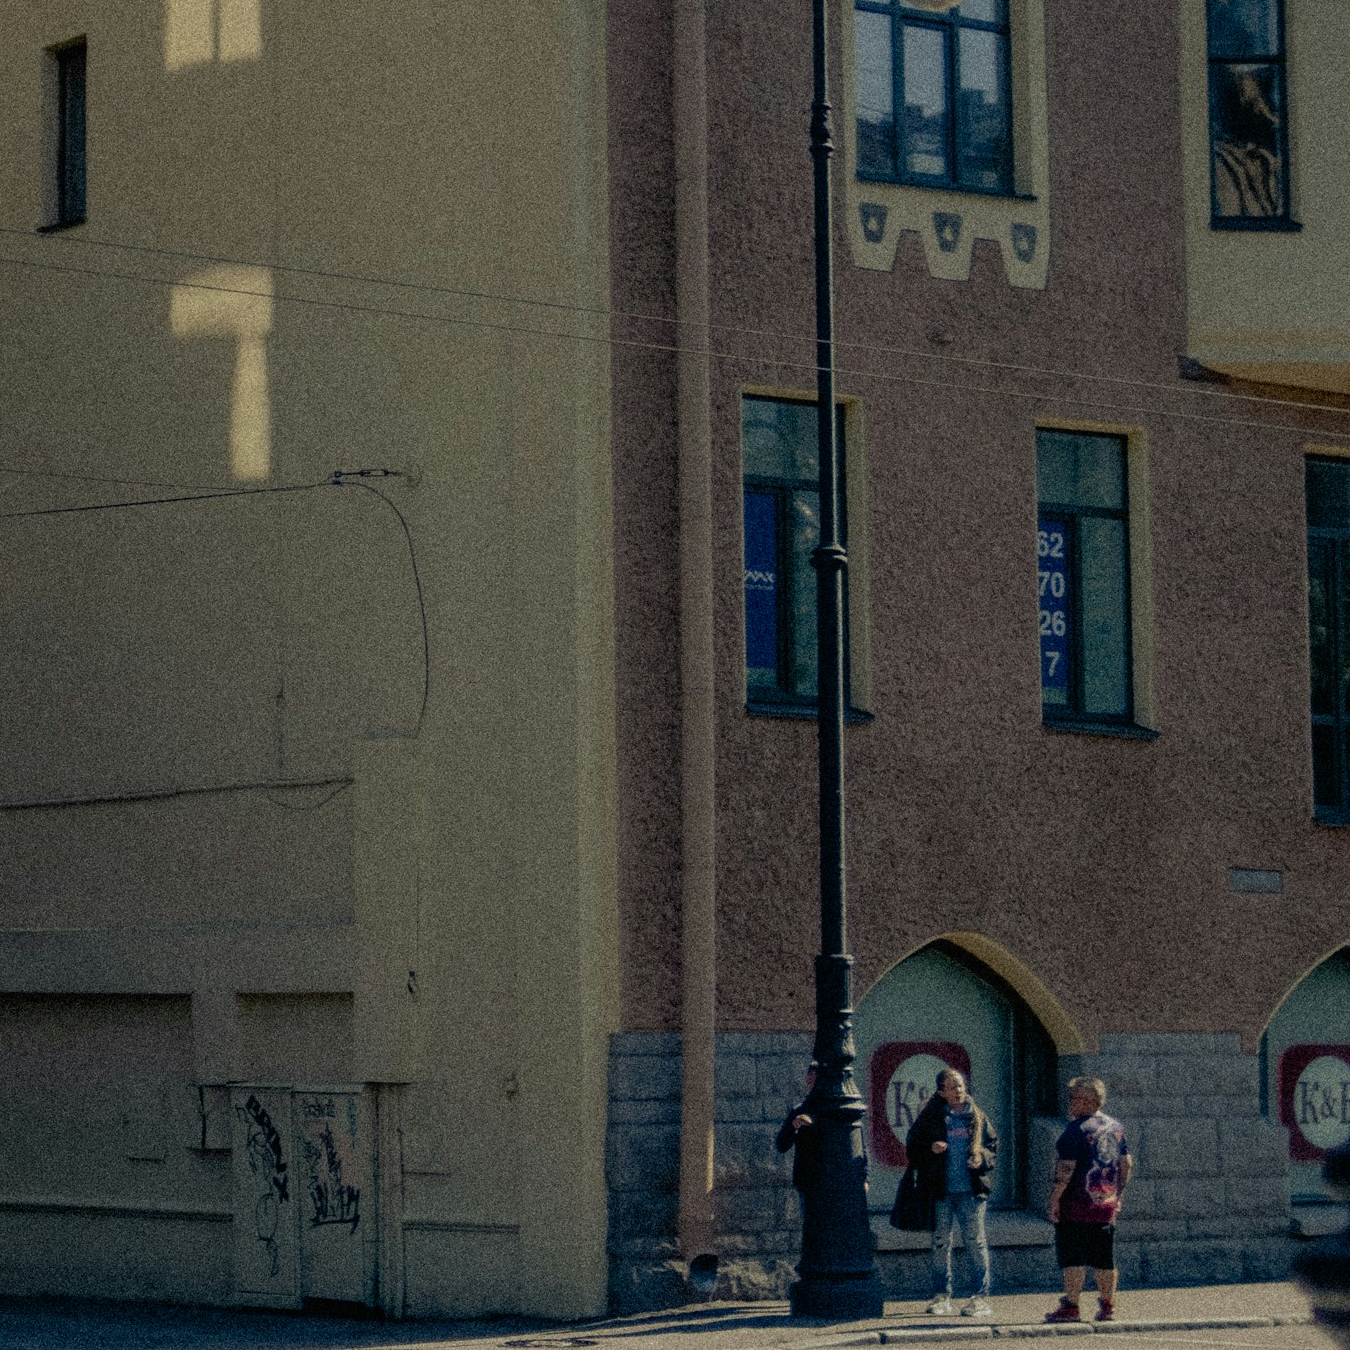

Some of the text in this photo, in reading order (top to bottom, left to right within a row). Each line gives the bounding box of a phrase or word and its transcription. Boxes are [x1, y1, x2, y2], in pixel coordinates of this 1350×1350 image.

[1038, 571, 1065, 598] 70
[1039, 610, 1066, 637] 26
[1045, 650, 1061, 677] 7
